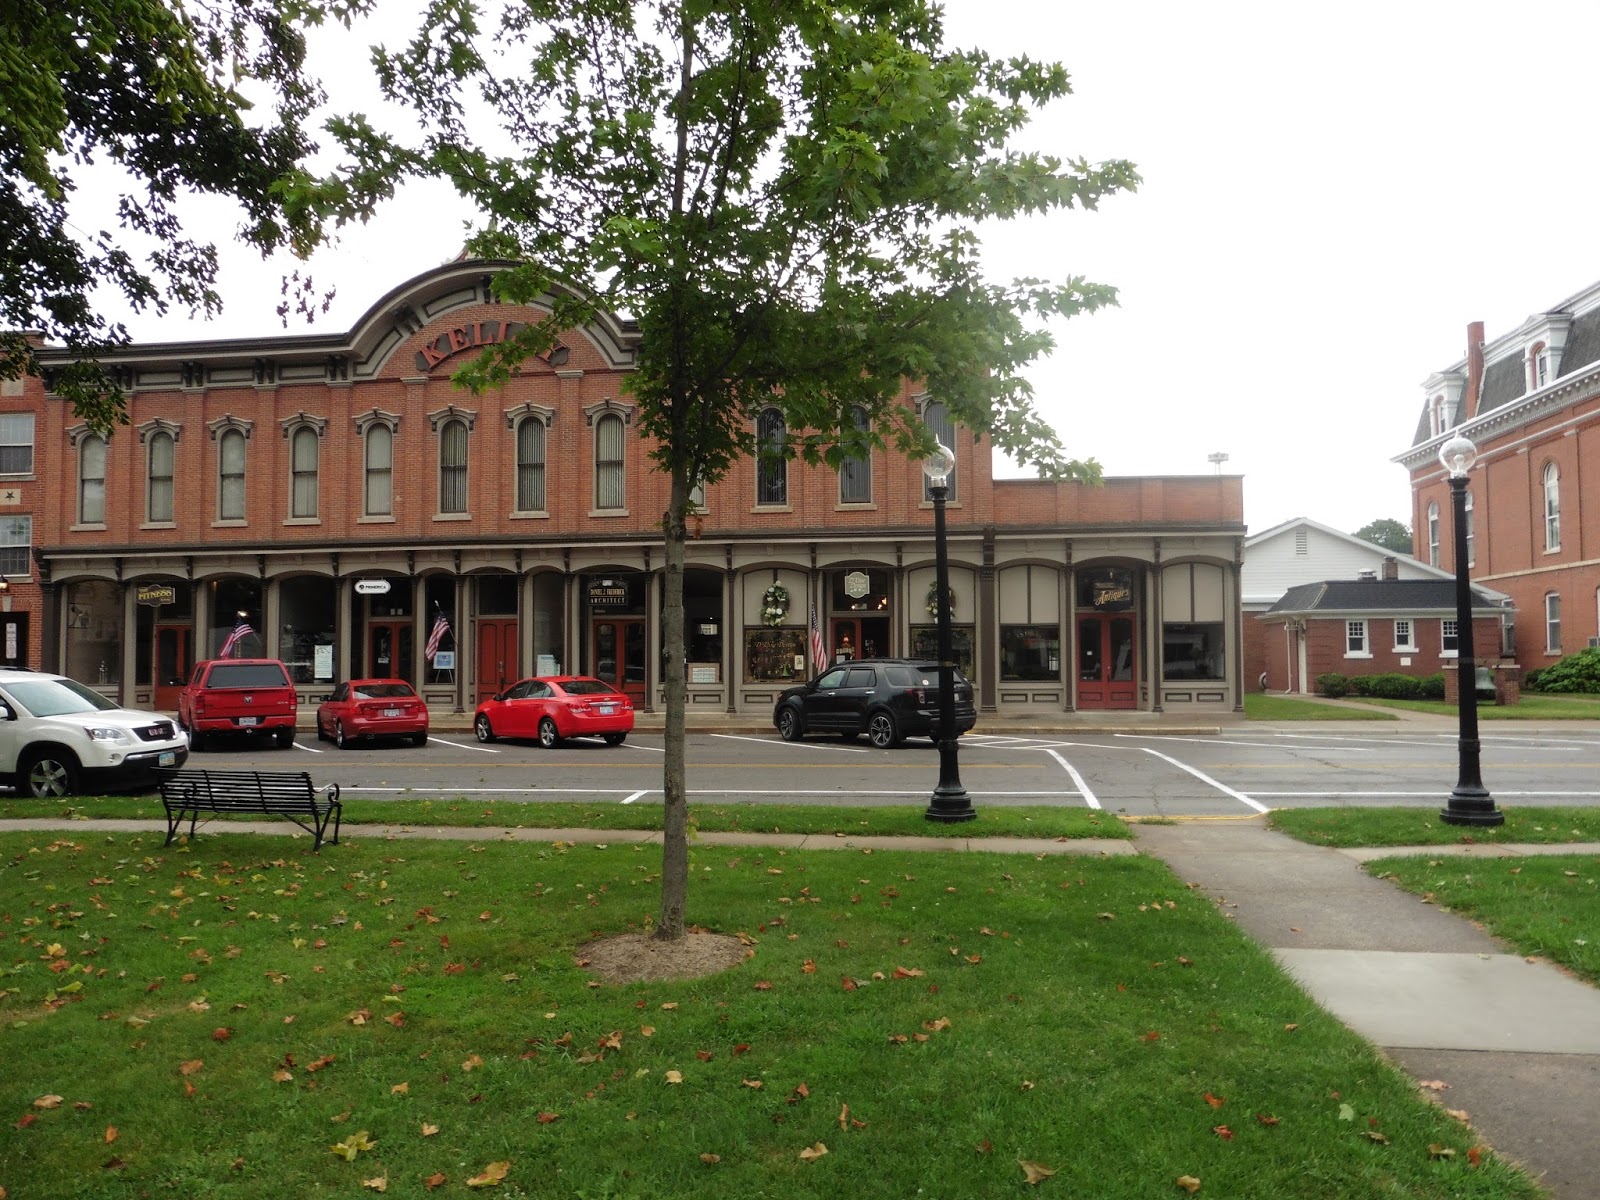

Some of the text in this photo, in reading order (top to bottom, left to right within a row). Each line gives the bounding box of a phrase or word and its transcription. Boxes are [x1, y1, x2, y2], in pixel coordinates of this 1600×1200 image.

[420, 321, 569, 369] KELLY
[138, 590, 172, 600] FITNESS
[1095, 590, 1129, 605] Antiques
